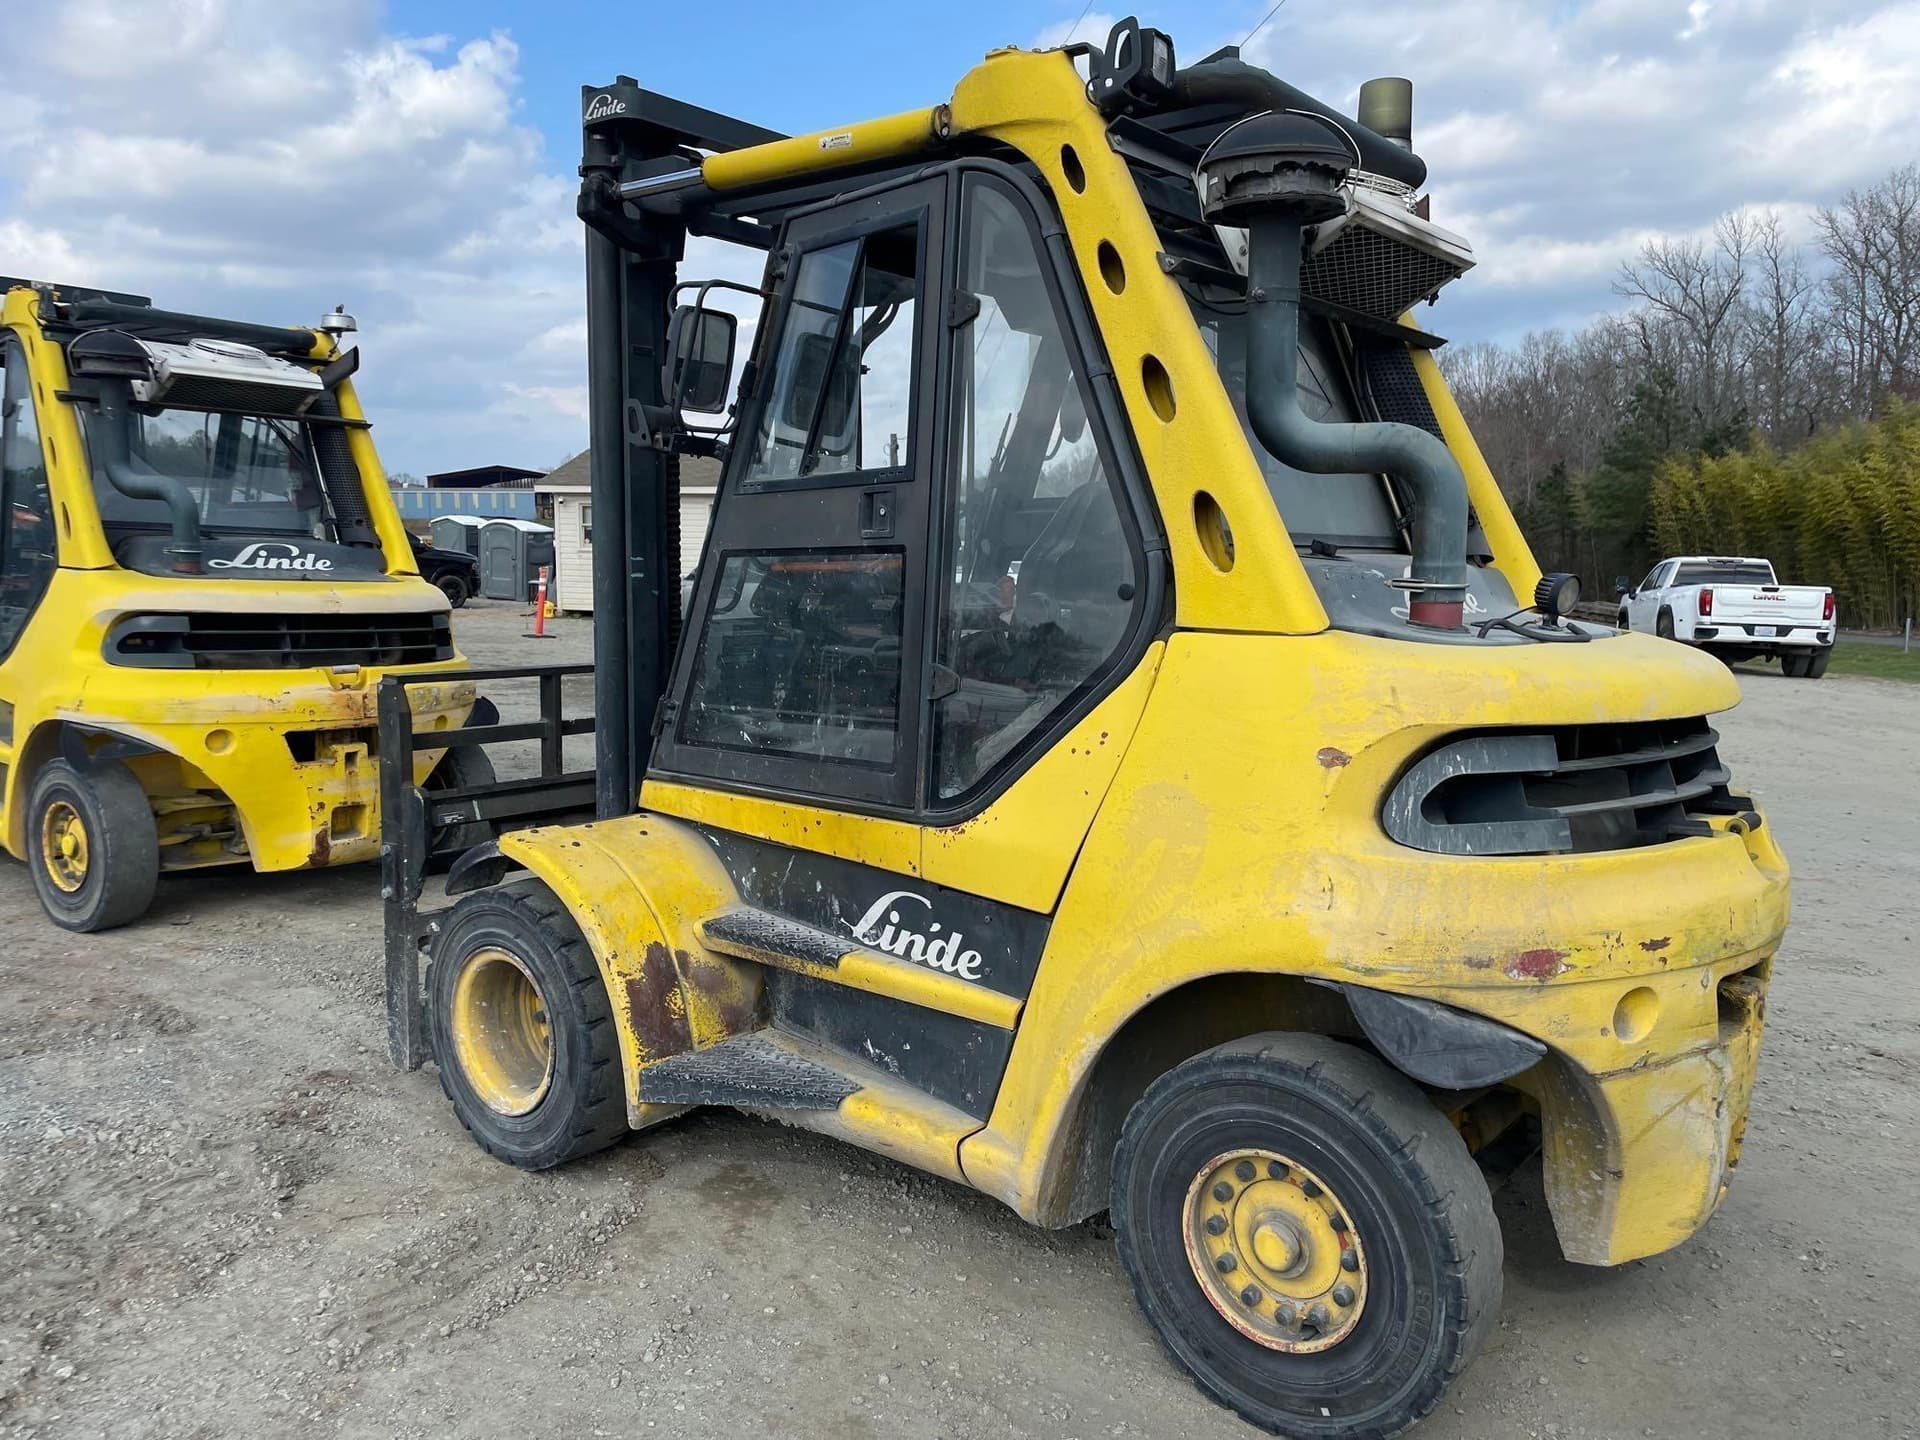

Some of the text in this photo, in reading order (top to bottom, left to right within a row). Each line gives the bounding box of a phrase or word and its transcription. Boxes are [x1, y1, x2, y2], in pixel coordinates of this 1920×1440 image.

[584, 94, 626, 121] Linde
[208, 542, 334, 571] Linde
[1752, 594, 1786, 602] GMC
[840, 891, 982, 980] Linde
